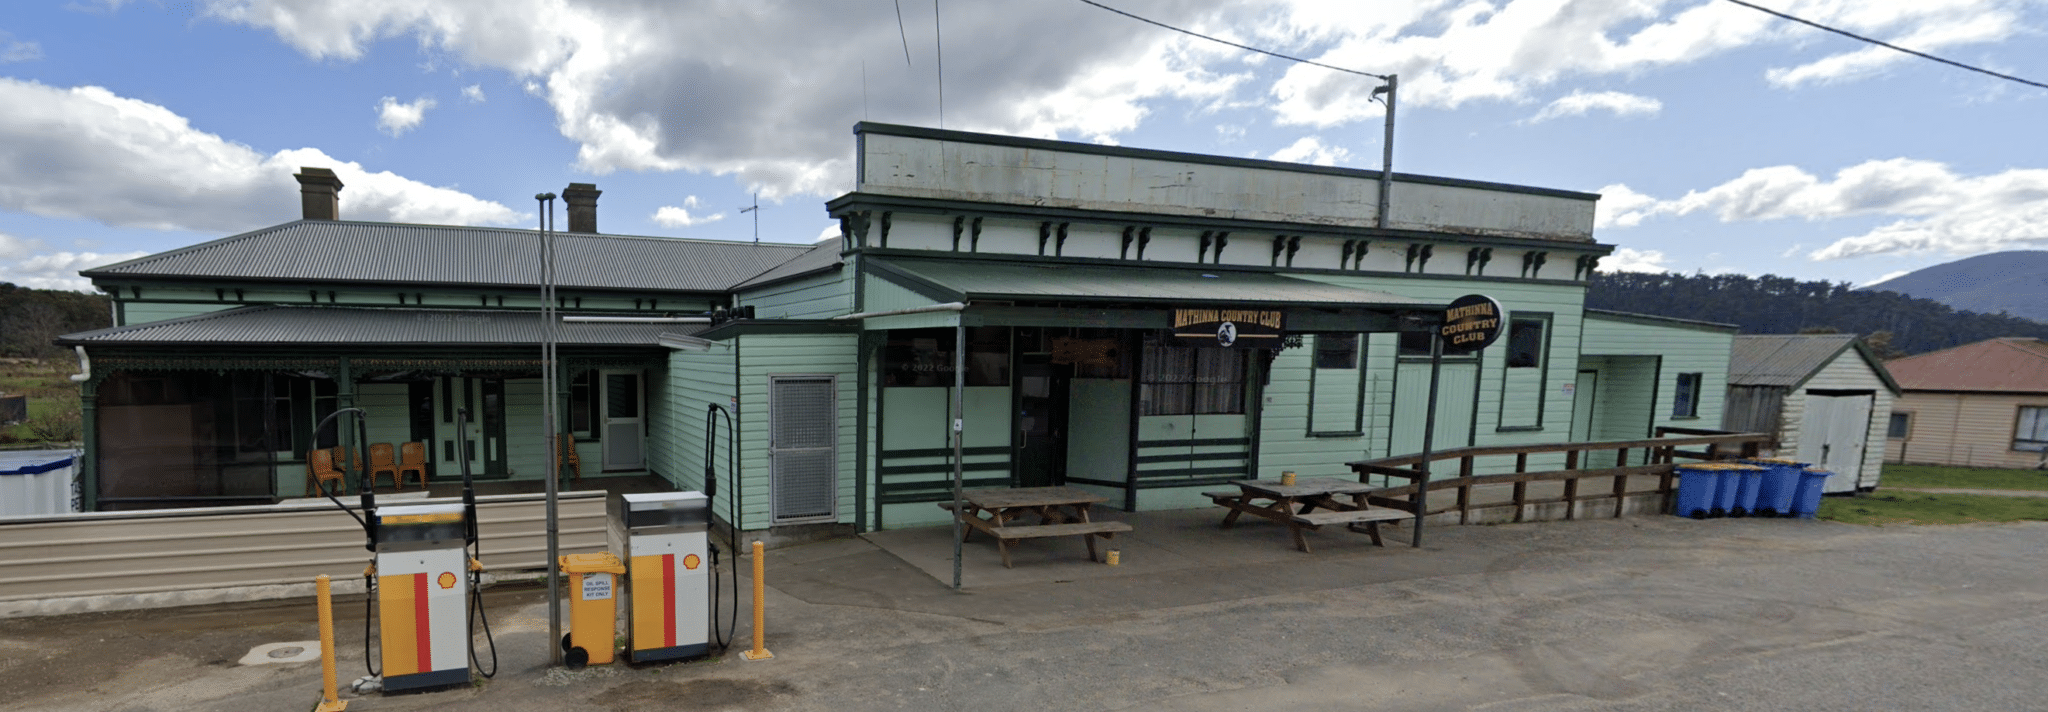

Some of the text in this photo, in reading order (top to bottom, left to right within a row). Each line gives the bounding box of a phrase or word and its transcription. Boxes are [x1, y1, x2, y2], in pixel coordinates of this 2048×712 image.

[1174, 309, 1281, 329] MATHINNA COUNTRY CLUB
[1446, 302, 1493, 323] MATHINNA
[1441, 317, 1497, 336] COUNTRY
[1453, 331, 1485, 345] CLUB
